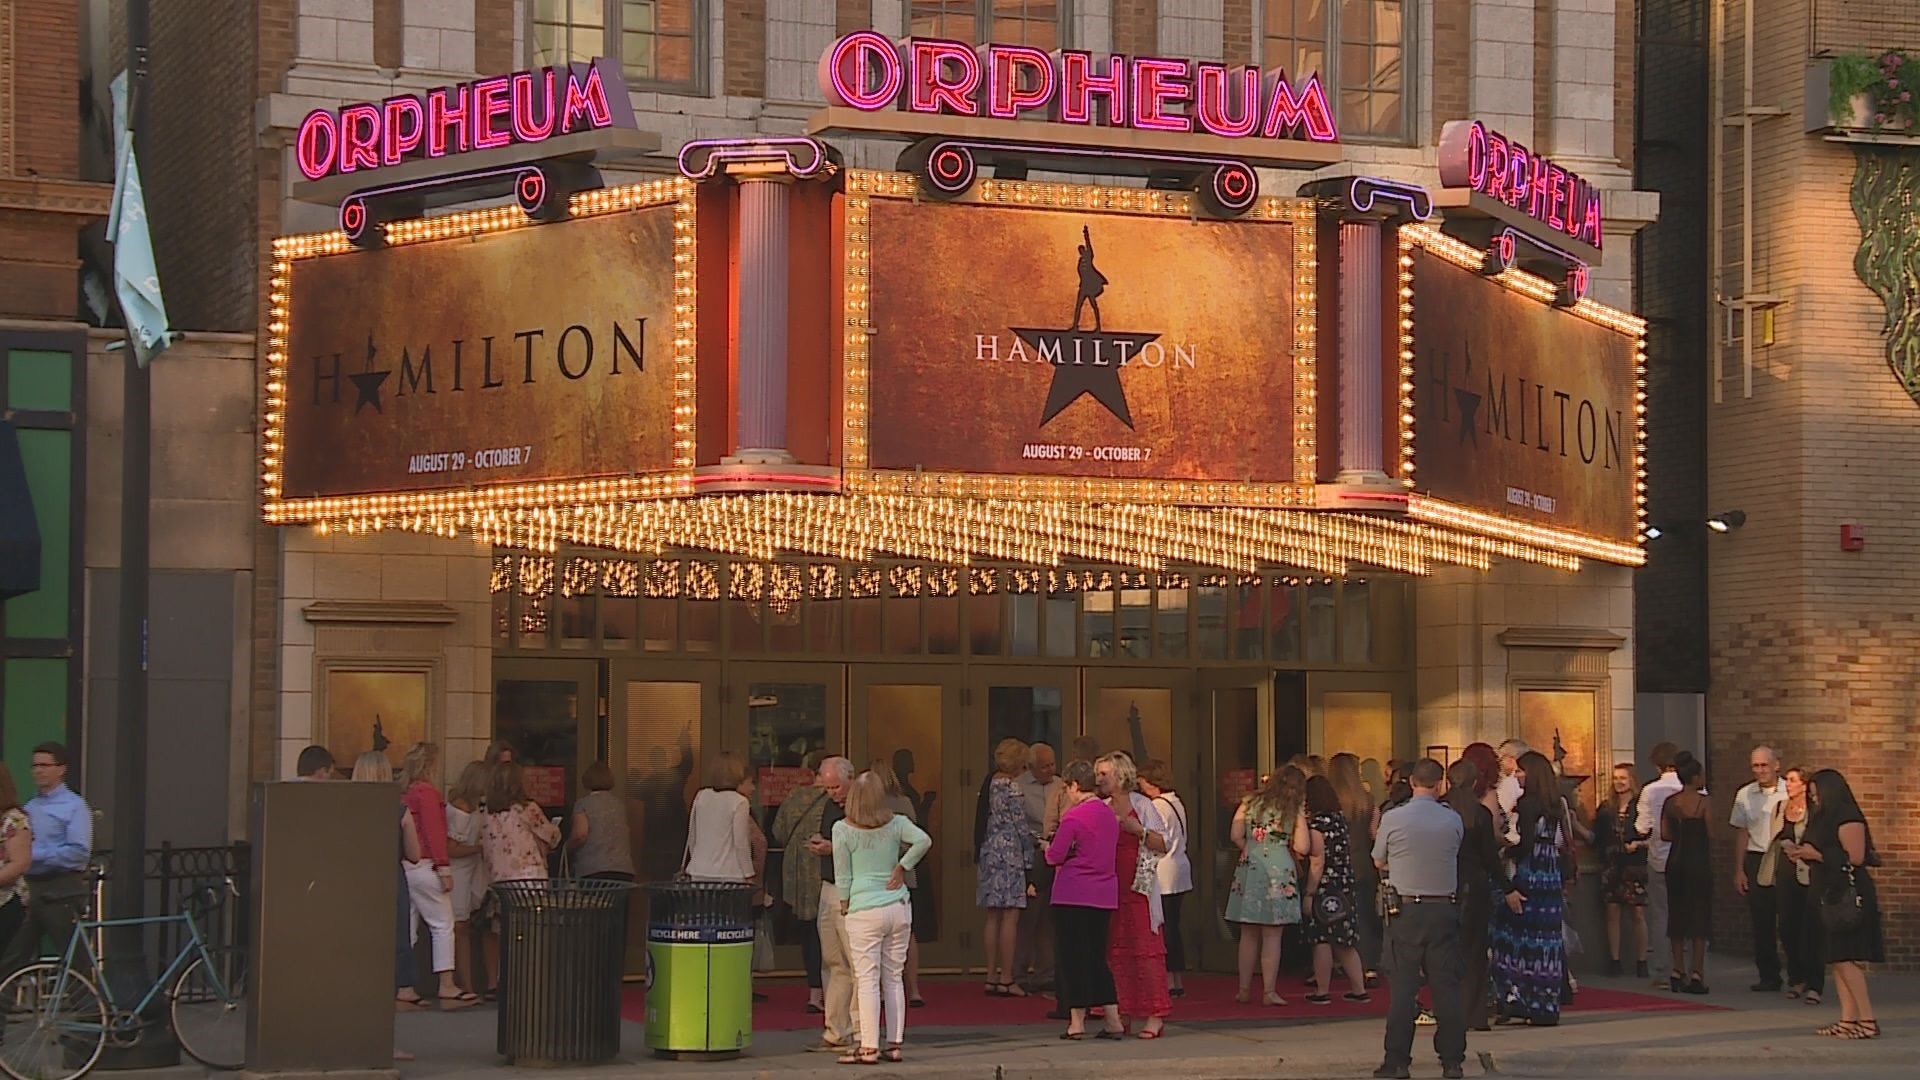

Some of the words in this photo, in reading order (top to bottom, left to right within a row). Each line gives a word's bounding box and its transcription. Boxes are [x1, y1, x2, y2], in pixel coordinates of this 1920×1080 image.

[828, 31, 1337, 143] ORPHEUM
[296, 60, 613, 181] ORPHEUM
[1468, 121, 1602, 248] ORPHEUM
[975, 334, 1198, 369] HAMILTON
[408, 454, 449, 473] AUGUST
[451, 452, 465, 470] 29
[475, 447, 521, 469] OCTOBER
[524, 446, 532, 464] 7
[1022, 444, 1066, 459] AUGUST
[1068, 446, 1083, 460] 29
[1093, 446, 1141, 461] OCTOBER
[1143, 448, 1152, 461] 7
[677, 930, 701, 940] HERE
[717, 930, 745, 940] RECYCLE
